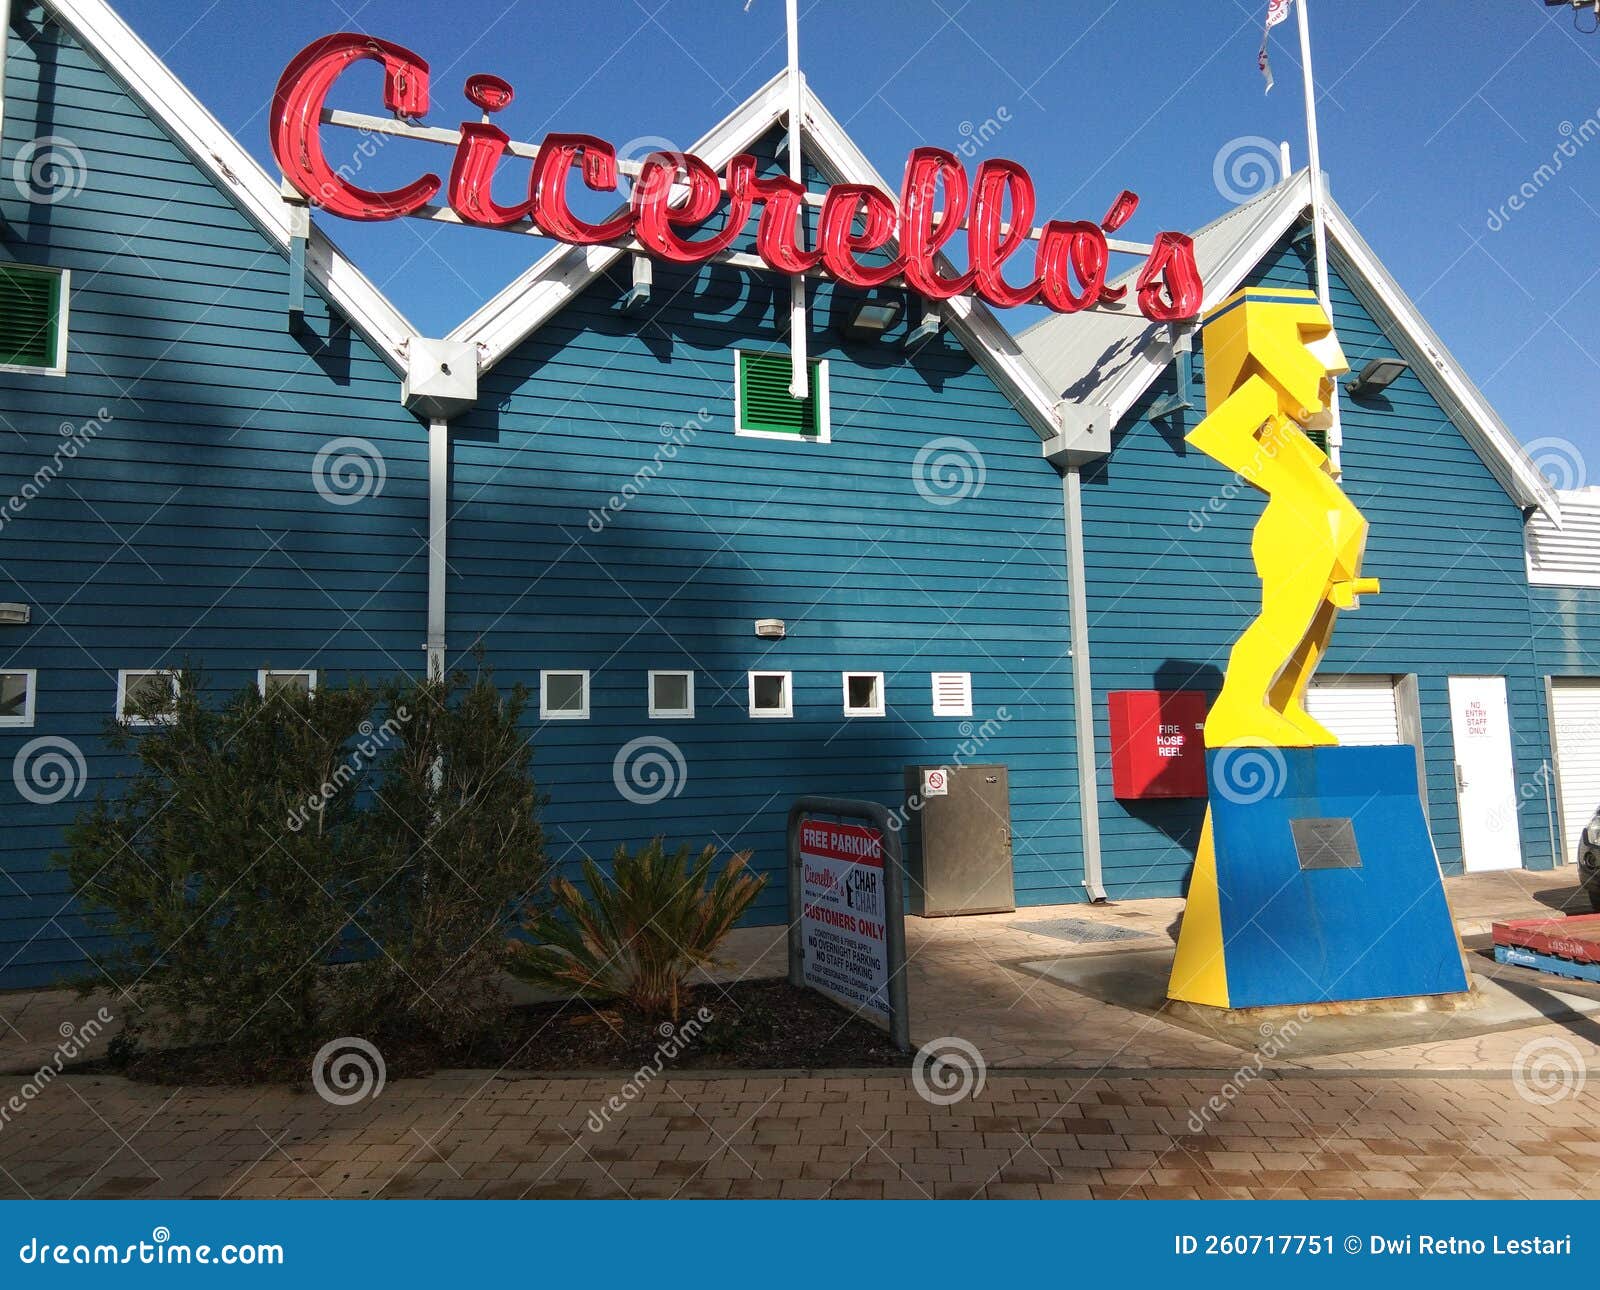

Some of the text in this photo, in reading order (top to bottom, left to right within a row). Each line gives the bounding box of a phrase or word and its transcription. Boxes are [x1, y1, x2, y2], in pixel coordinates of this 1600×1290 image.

[269, 32, 1206, 322] Cicerello's
[1470, 701, 1480, 709] NO
[1465, 709, 1487, 717] ENTRY
[1466, 718, 1487, 726] STAFF
[1158, 724, 1181, 734] FIRE
[1469, 727, 1487, 735] ONLY
[1156, 735, 1184, 746] HOSE
[1158, 747, 1183, 757] REEL
[803, 828, 881, 859] FREE PARKING
[854, 869, 876, 894] CHAR
[804, 903, 885, 941] CUSTOMERS ONLY
[808, 935, 881, 970] NO OVERNIGHT PARKING
[816, 950, 873, 980] NO STAFF PARKING
